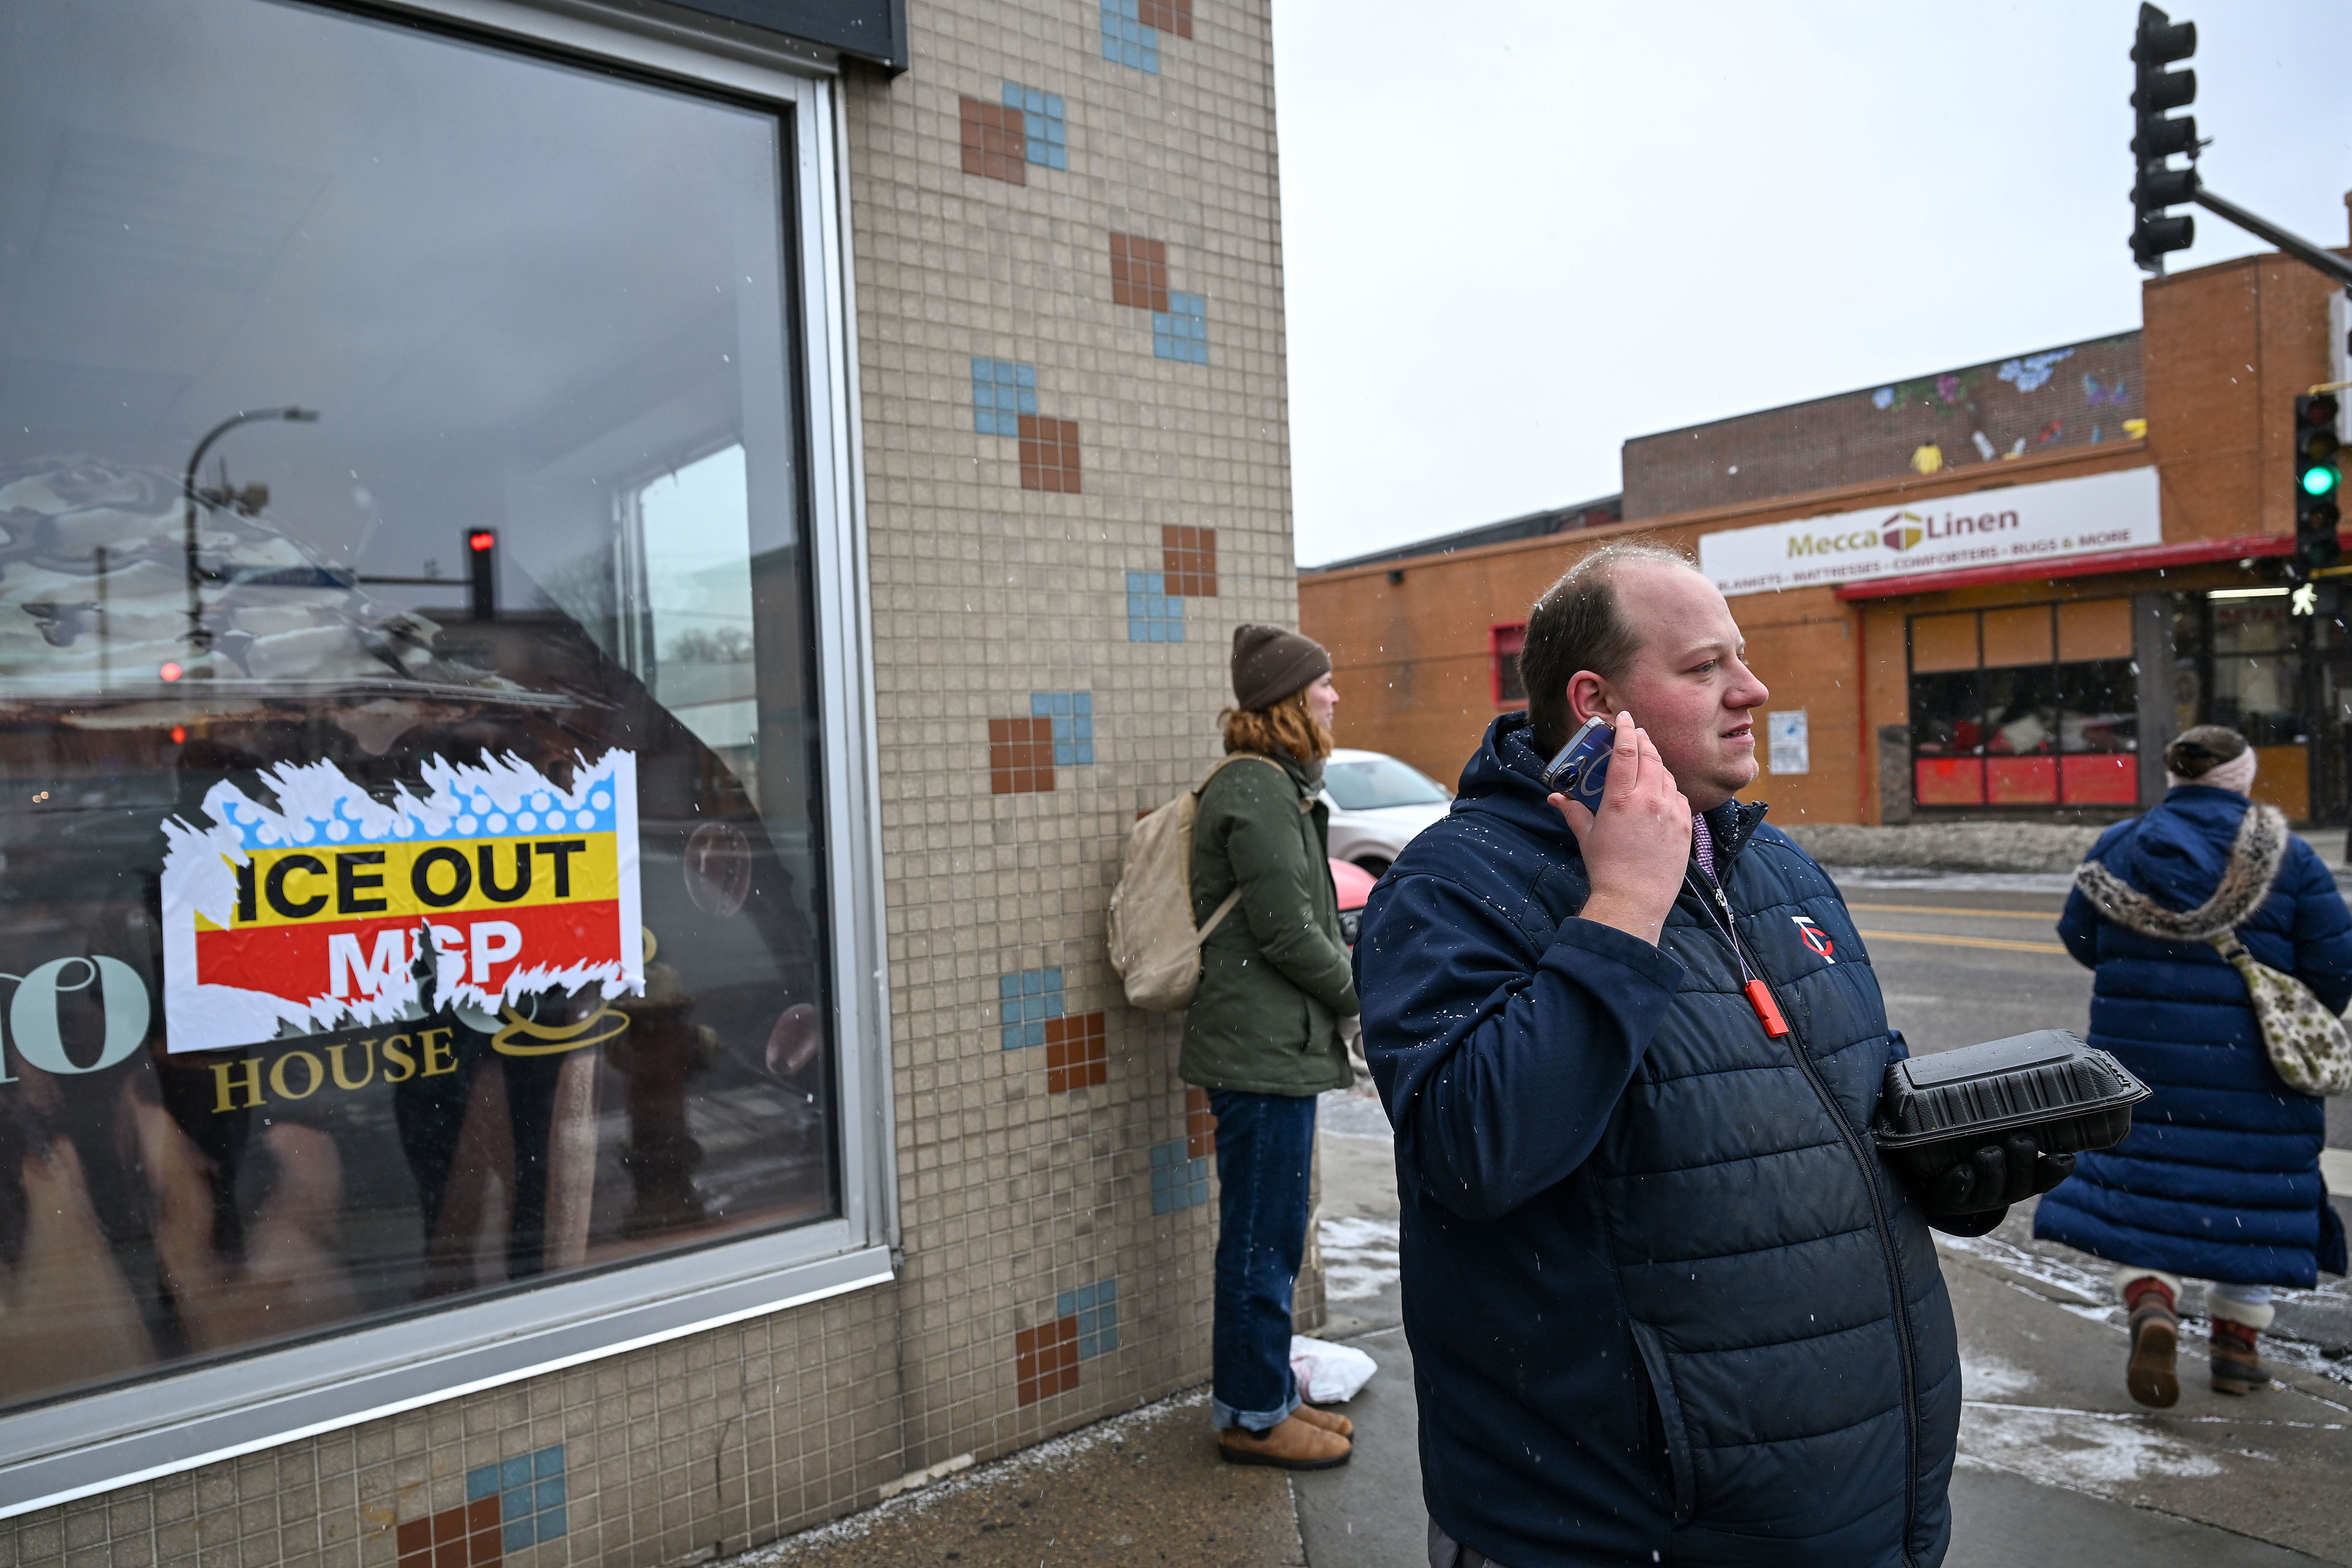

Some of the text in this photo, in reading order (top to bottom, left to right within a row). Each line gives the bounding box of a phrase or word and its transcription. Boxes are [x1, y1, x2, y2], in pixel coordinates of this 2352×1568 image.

[1718, 528, 2131, 590] BLANKETS MATTRESSES COMFORTERS RUGS & MORE
[1788, 509, 2018, 557] Mecca Linen
[237, 840, 585, 922] ICE OUT
[209, 1027, 459, 1113] HOUSE
